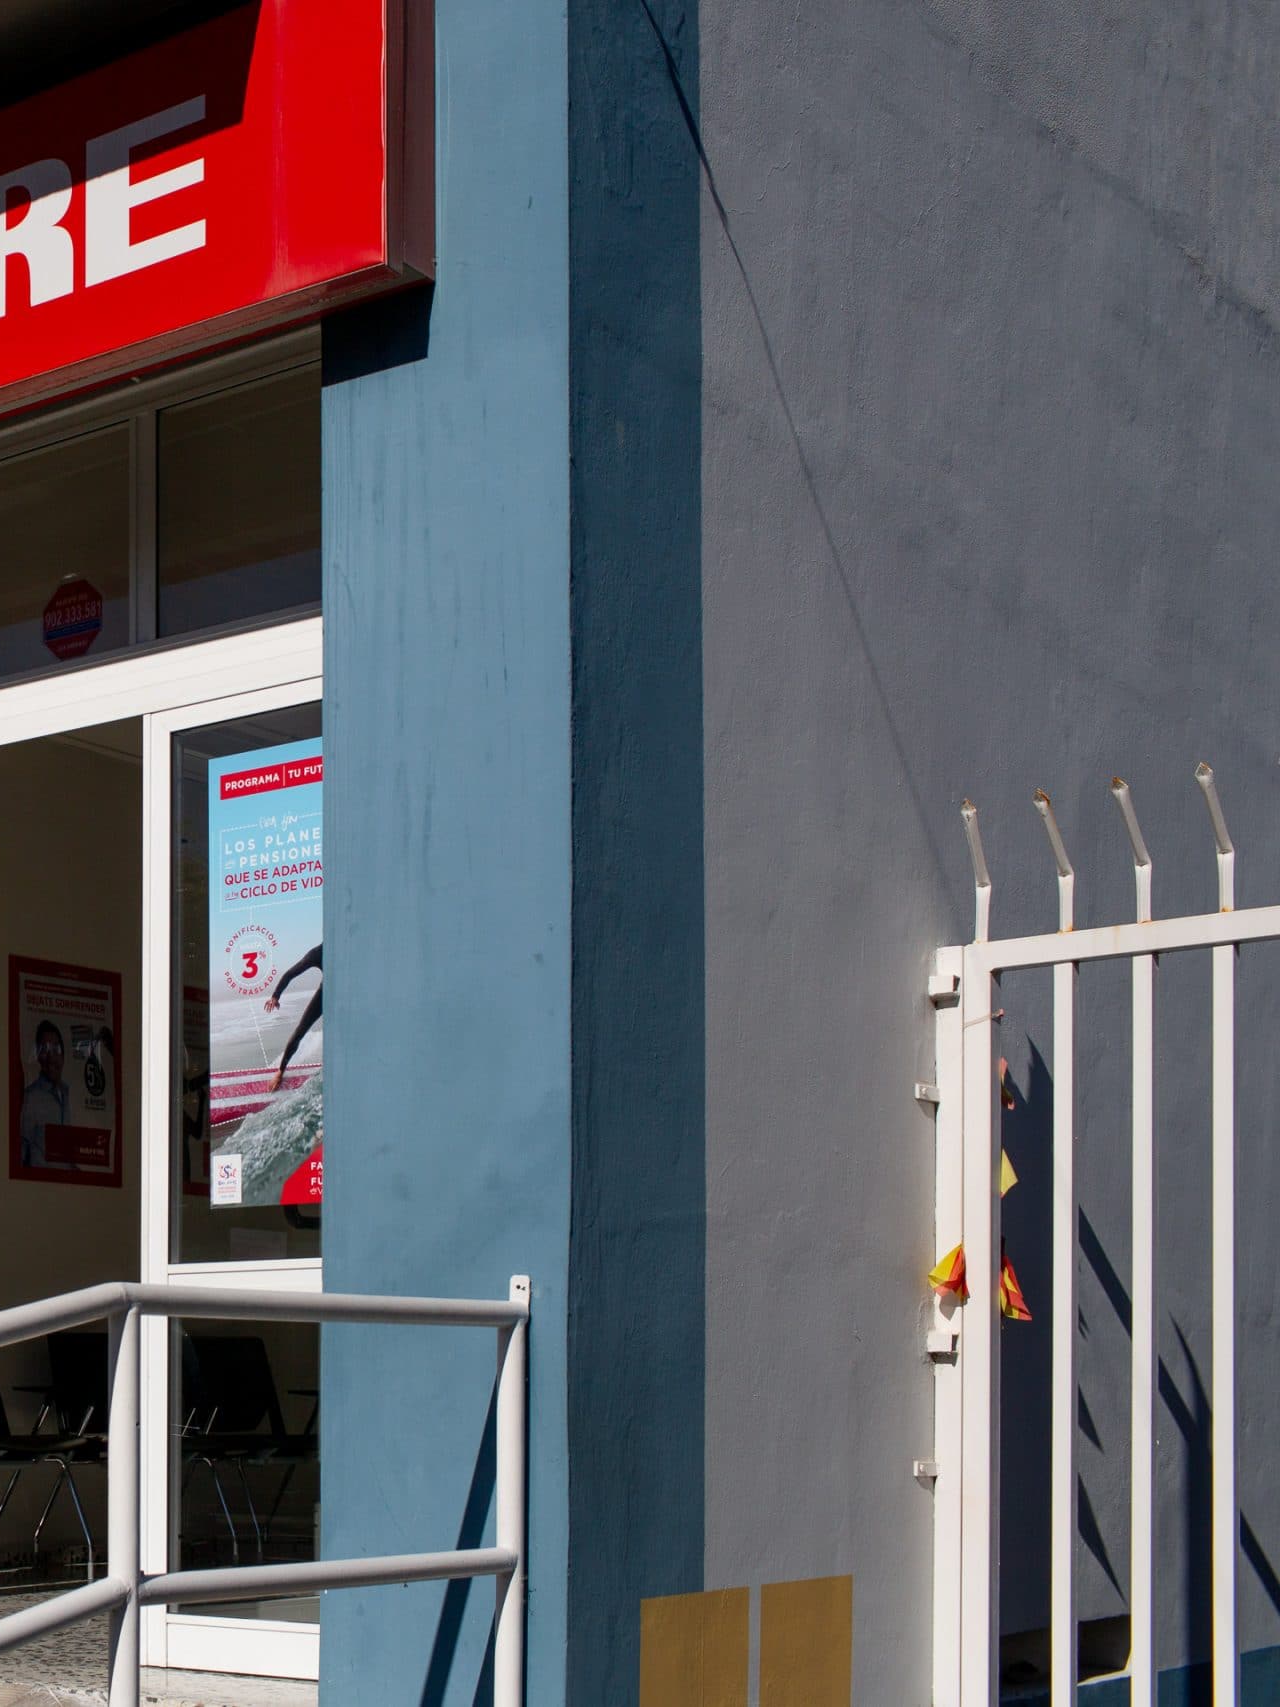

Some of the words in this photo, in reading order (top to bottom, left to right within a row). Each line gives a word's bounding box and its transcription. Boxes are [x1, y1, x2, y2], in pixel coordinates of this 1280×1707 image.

[225, 773, 280, 791] PROGRAMA
[288, 768, 301, 780] TU
[225, 839, 256, 855] LOS
[265, 827, 321, 848] PLANE
[239, 843, 322, 868] PENSIONE
[225, 872, 250, 887] QUE
[254, 868, 269, 881] SE
[272, 860, 323, 879] ADAPTA
[240, 883, 278, 899] CICLO
[281, 879, 298, 893] DE
